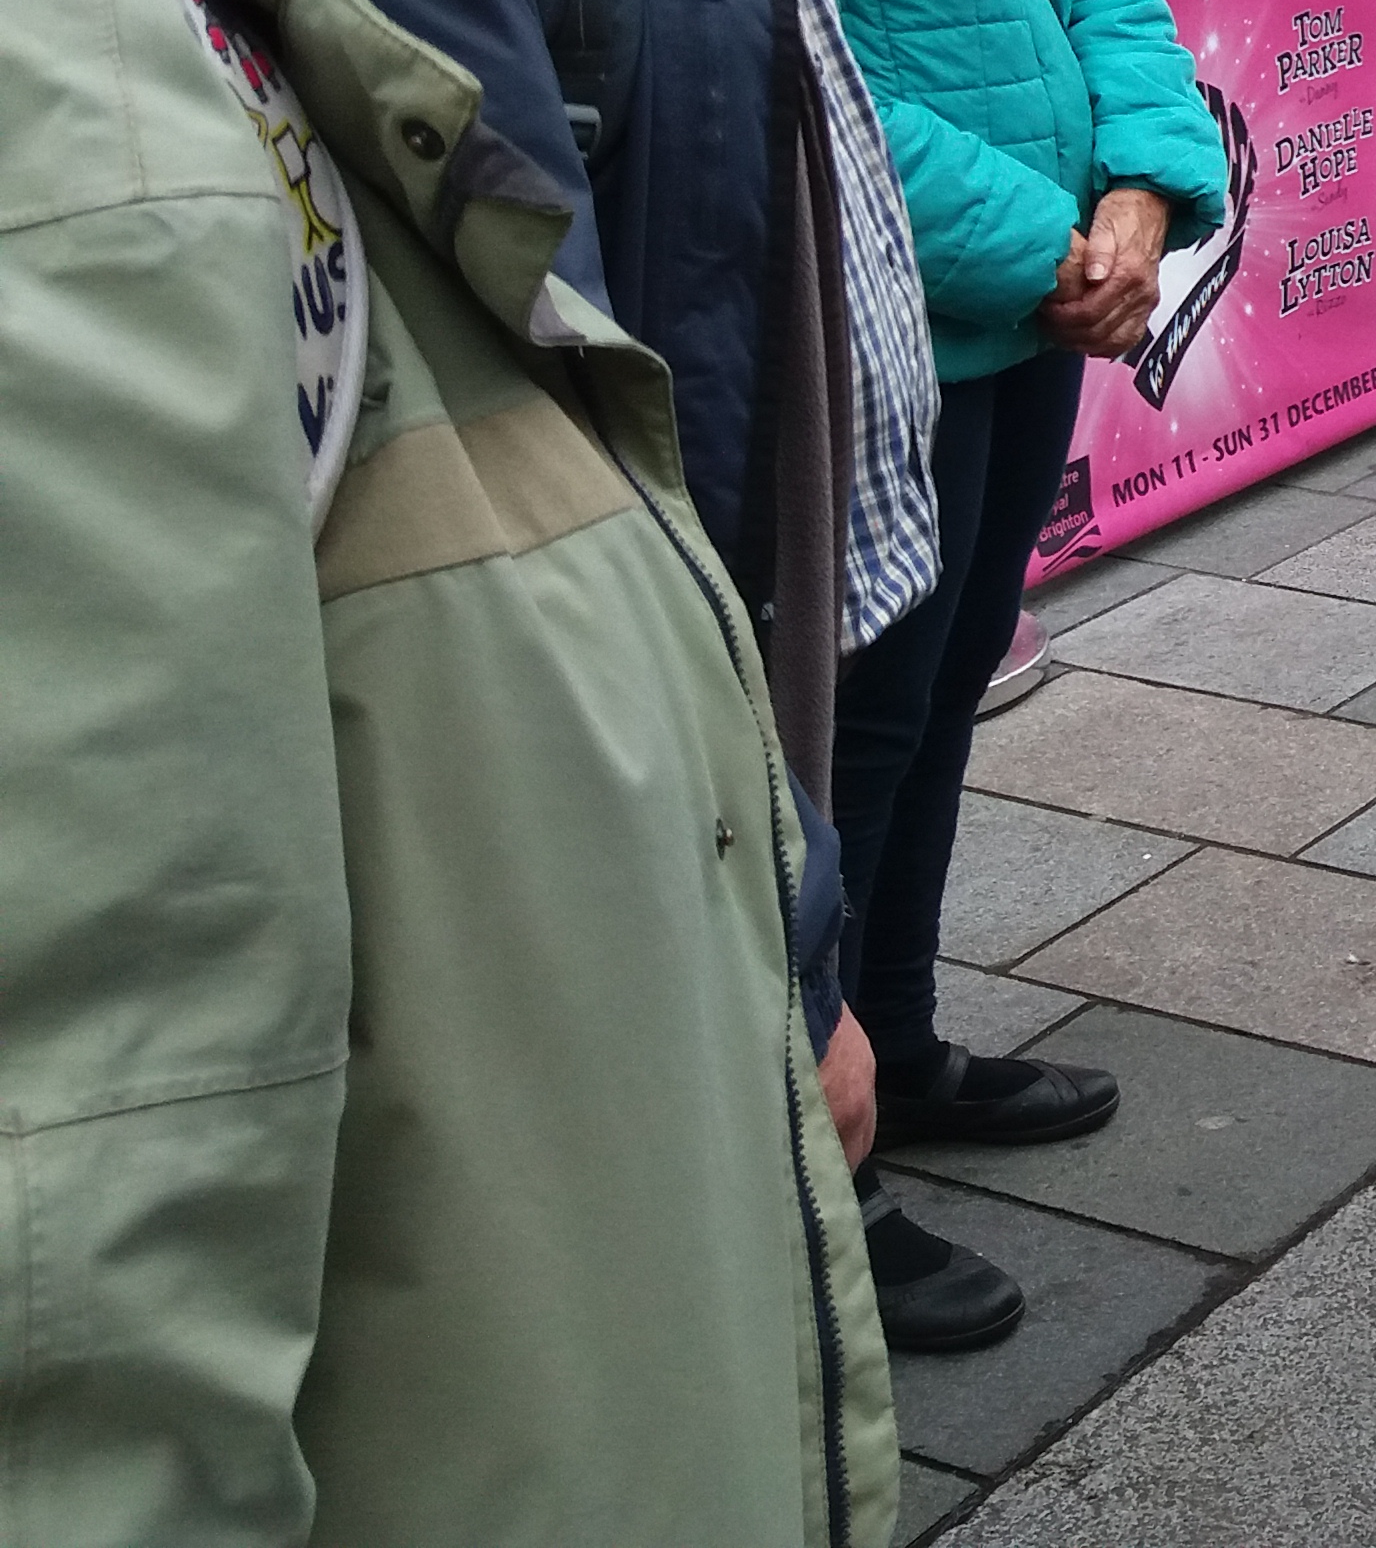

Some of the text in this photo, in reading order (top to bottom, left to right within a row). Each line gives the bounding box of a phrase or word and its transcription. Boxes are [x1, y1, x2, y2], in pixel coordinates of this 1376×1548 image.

[1293, 6, 1344, 49] TOM
[1275, 32, 1364, 95] PARKER
[1274, 107, 1374, 176] DANIELLE
[1300, 147, 1358, 198] HOPE
[1286, 216, 1372, 276] LOUISA
[1280, 251, 1376, 318] LYTTON
[1149, 353, 1165, 399] is
[1167, 312, 1192, 364] the
[1112, 462, 1167, 508] MON
[1171, 449, 1198, 481] 11
[1212, 424, 1254, 462] SUN
[1258, 411, 1281, 443] 31
